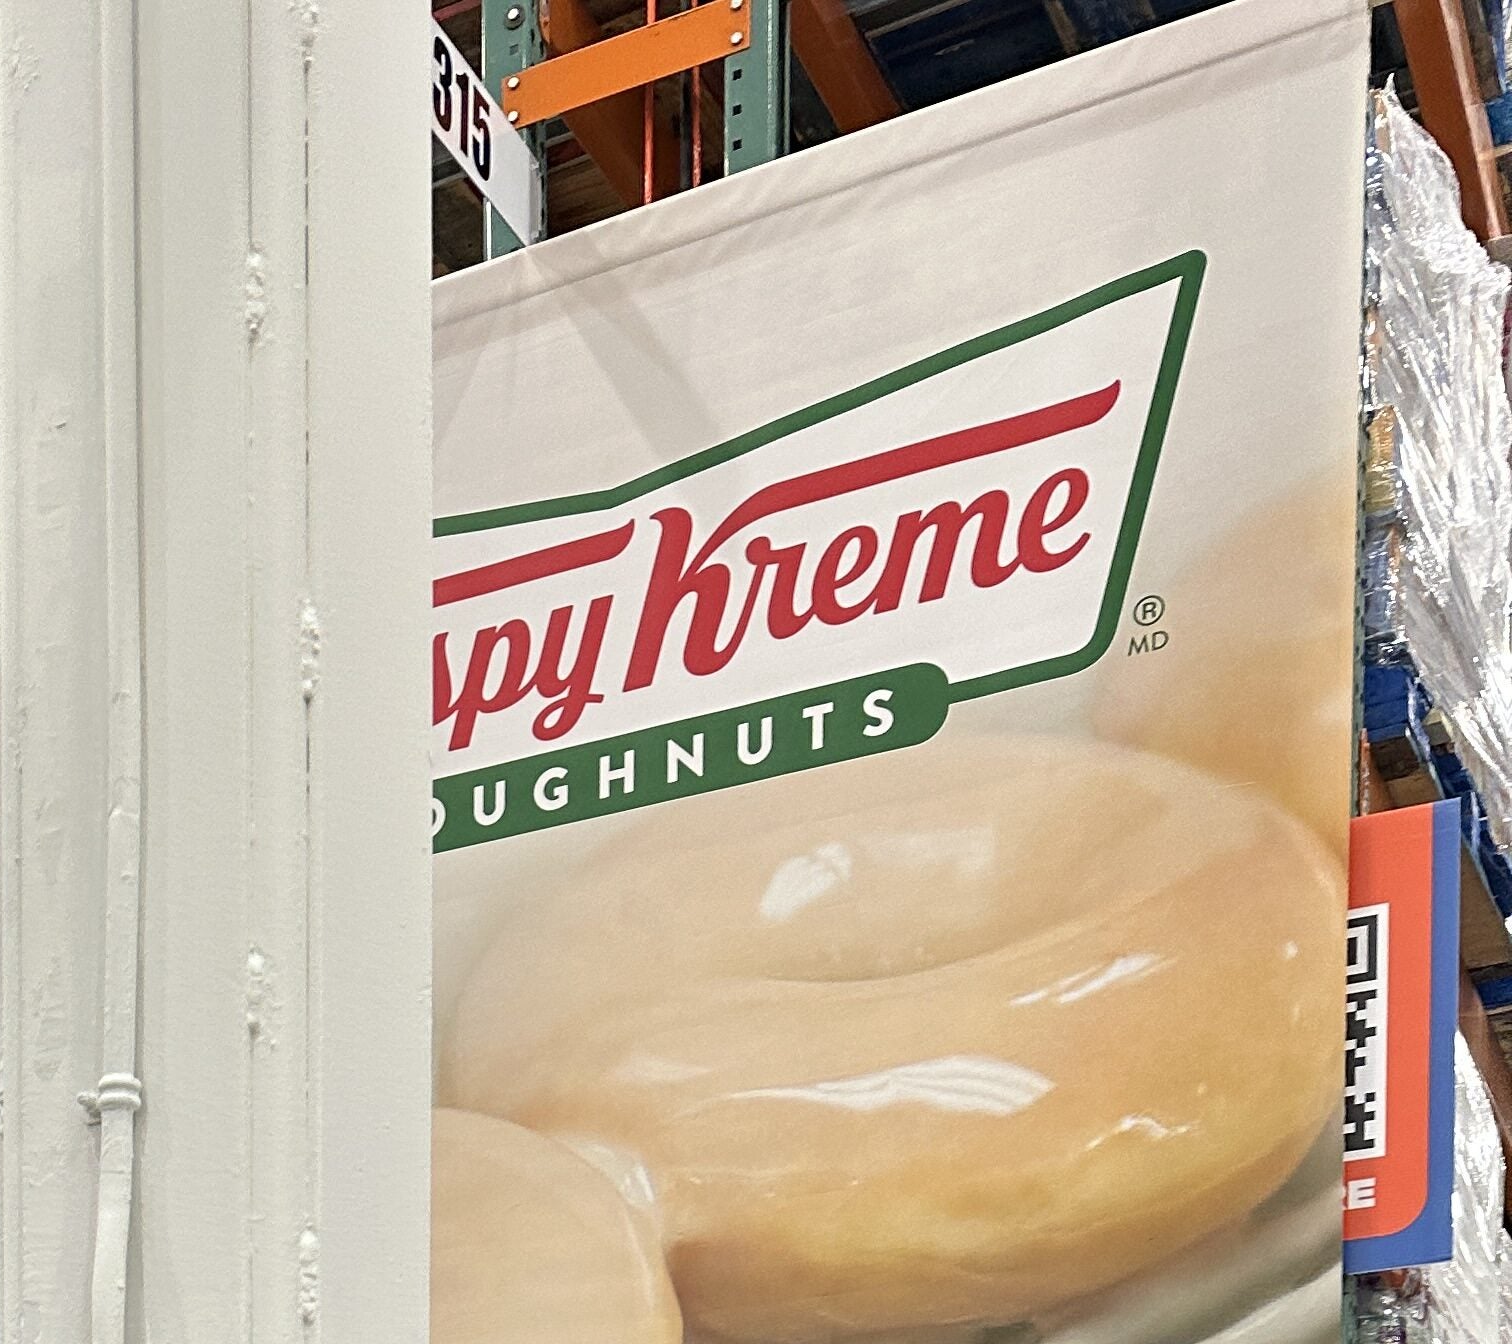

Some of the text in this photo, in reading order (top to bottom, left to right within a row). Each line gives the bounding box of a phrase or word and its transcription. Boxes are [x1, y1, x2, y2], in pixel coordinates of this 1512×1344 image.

[434, 36, 491, 181] 315
[433, 379, 1121, 751] spy Kreme
[1128, 630, 1169, 656] MD
[433, 690, 894, 838] UGHNUTS
[1343, 1177, 1376, 1211] E
